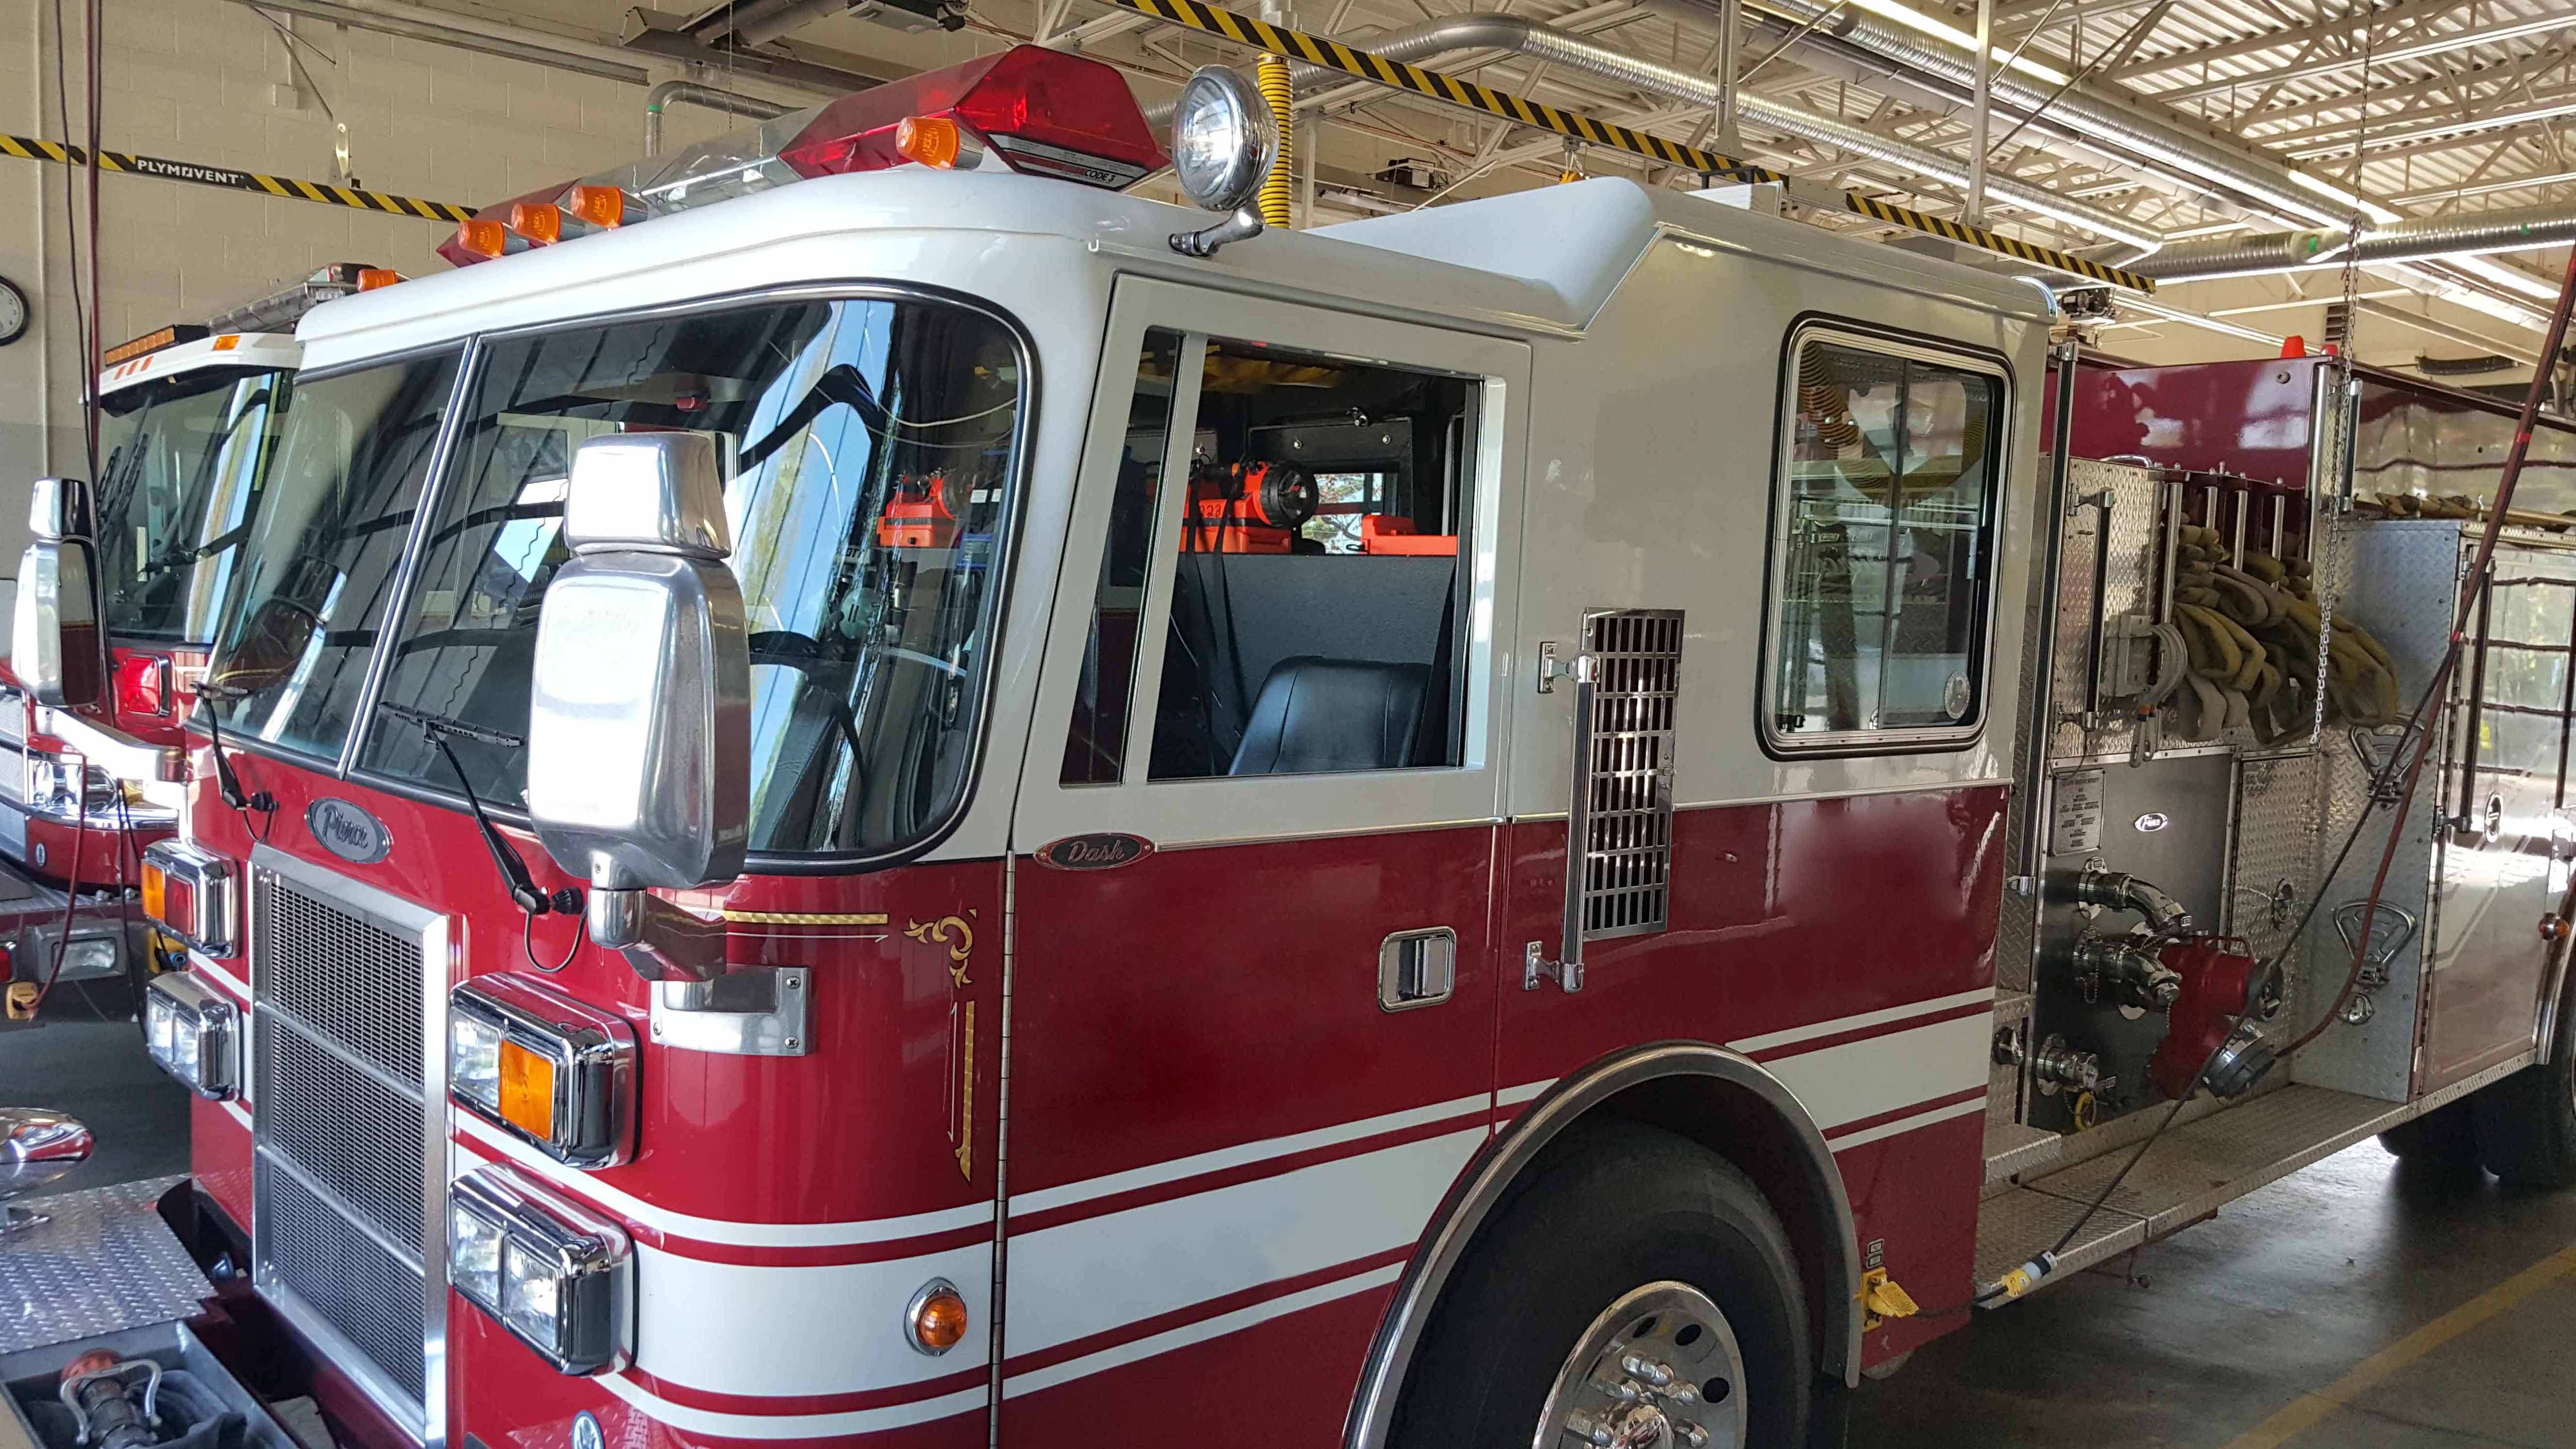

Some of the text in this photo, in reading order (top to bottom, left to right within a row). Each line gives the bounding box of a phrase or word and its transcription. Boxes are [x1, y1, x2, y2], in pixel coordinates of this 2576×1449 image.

[137, 159, 239, 184] PLYMOVENT
[1084, 169, 1110, 181] CODE
[322, 804, 369, 849] Pierce
[1068, 839, 1125, 862] Dash
